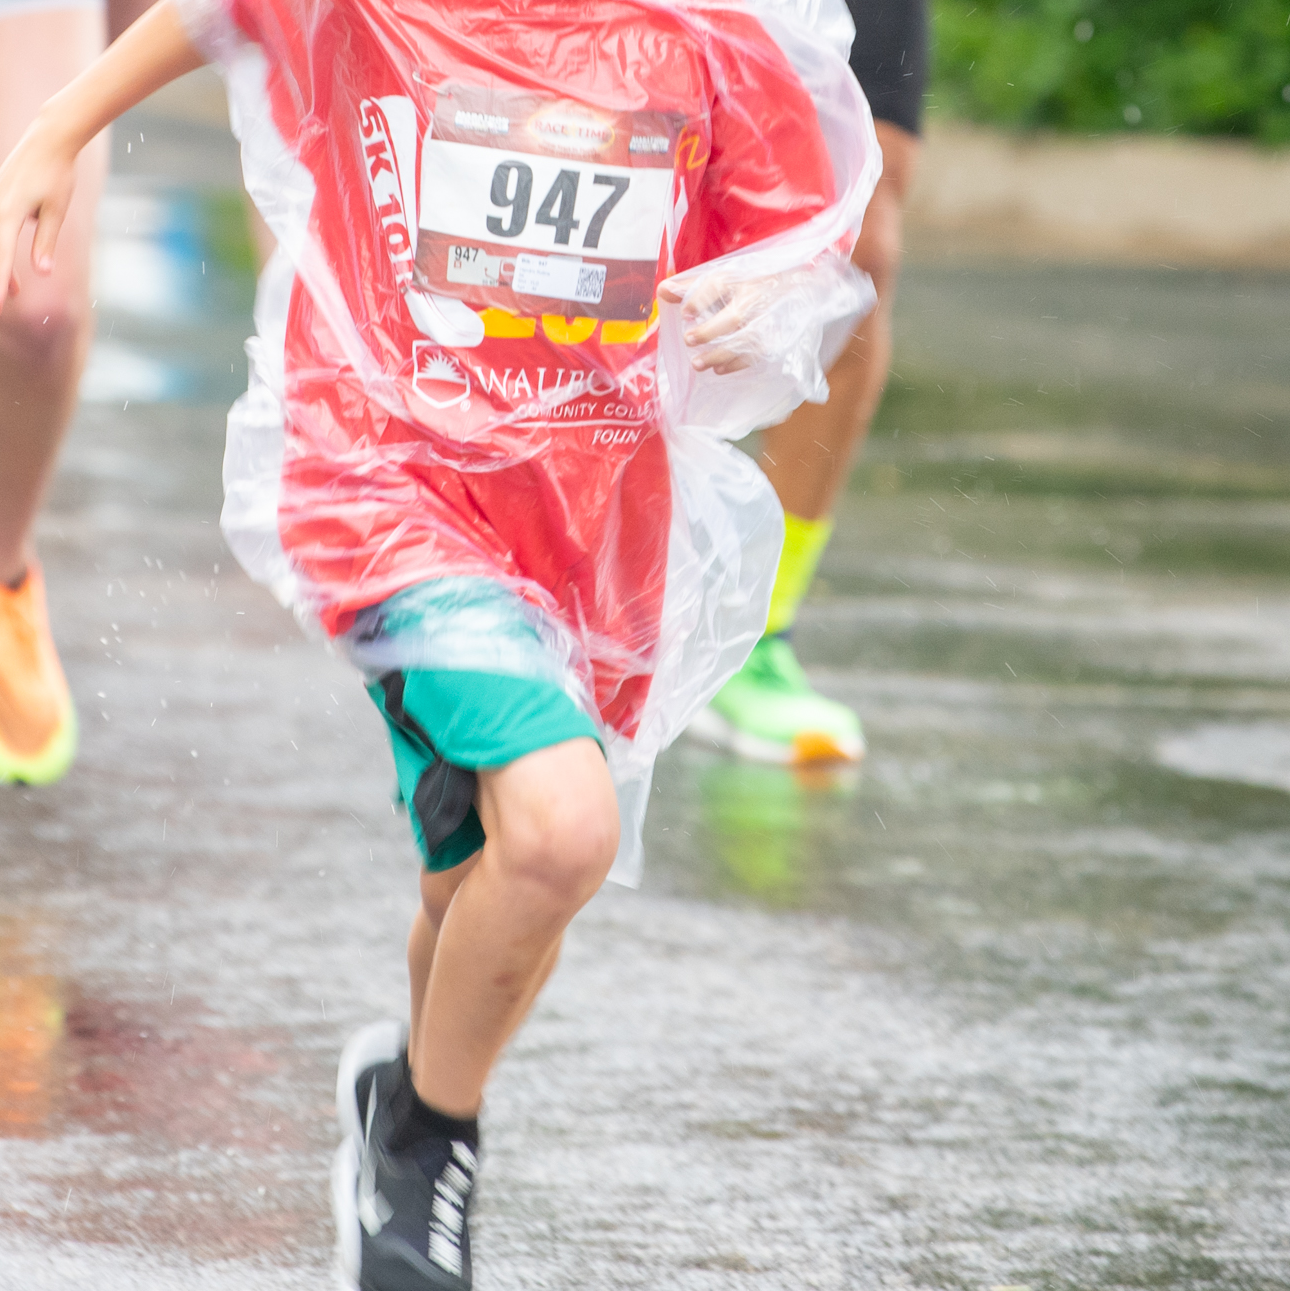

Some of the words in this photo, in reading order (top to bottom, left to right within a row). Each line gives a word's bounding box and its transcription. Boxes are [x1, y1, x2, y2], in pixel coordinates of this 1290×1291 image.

[360, 100, 395, 183] 5K
[534, 119, 567, 136] RACE
[486, 159, 631, 249] 947
[454, 246, 479, 263] 947
